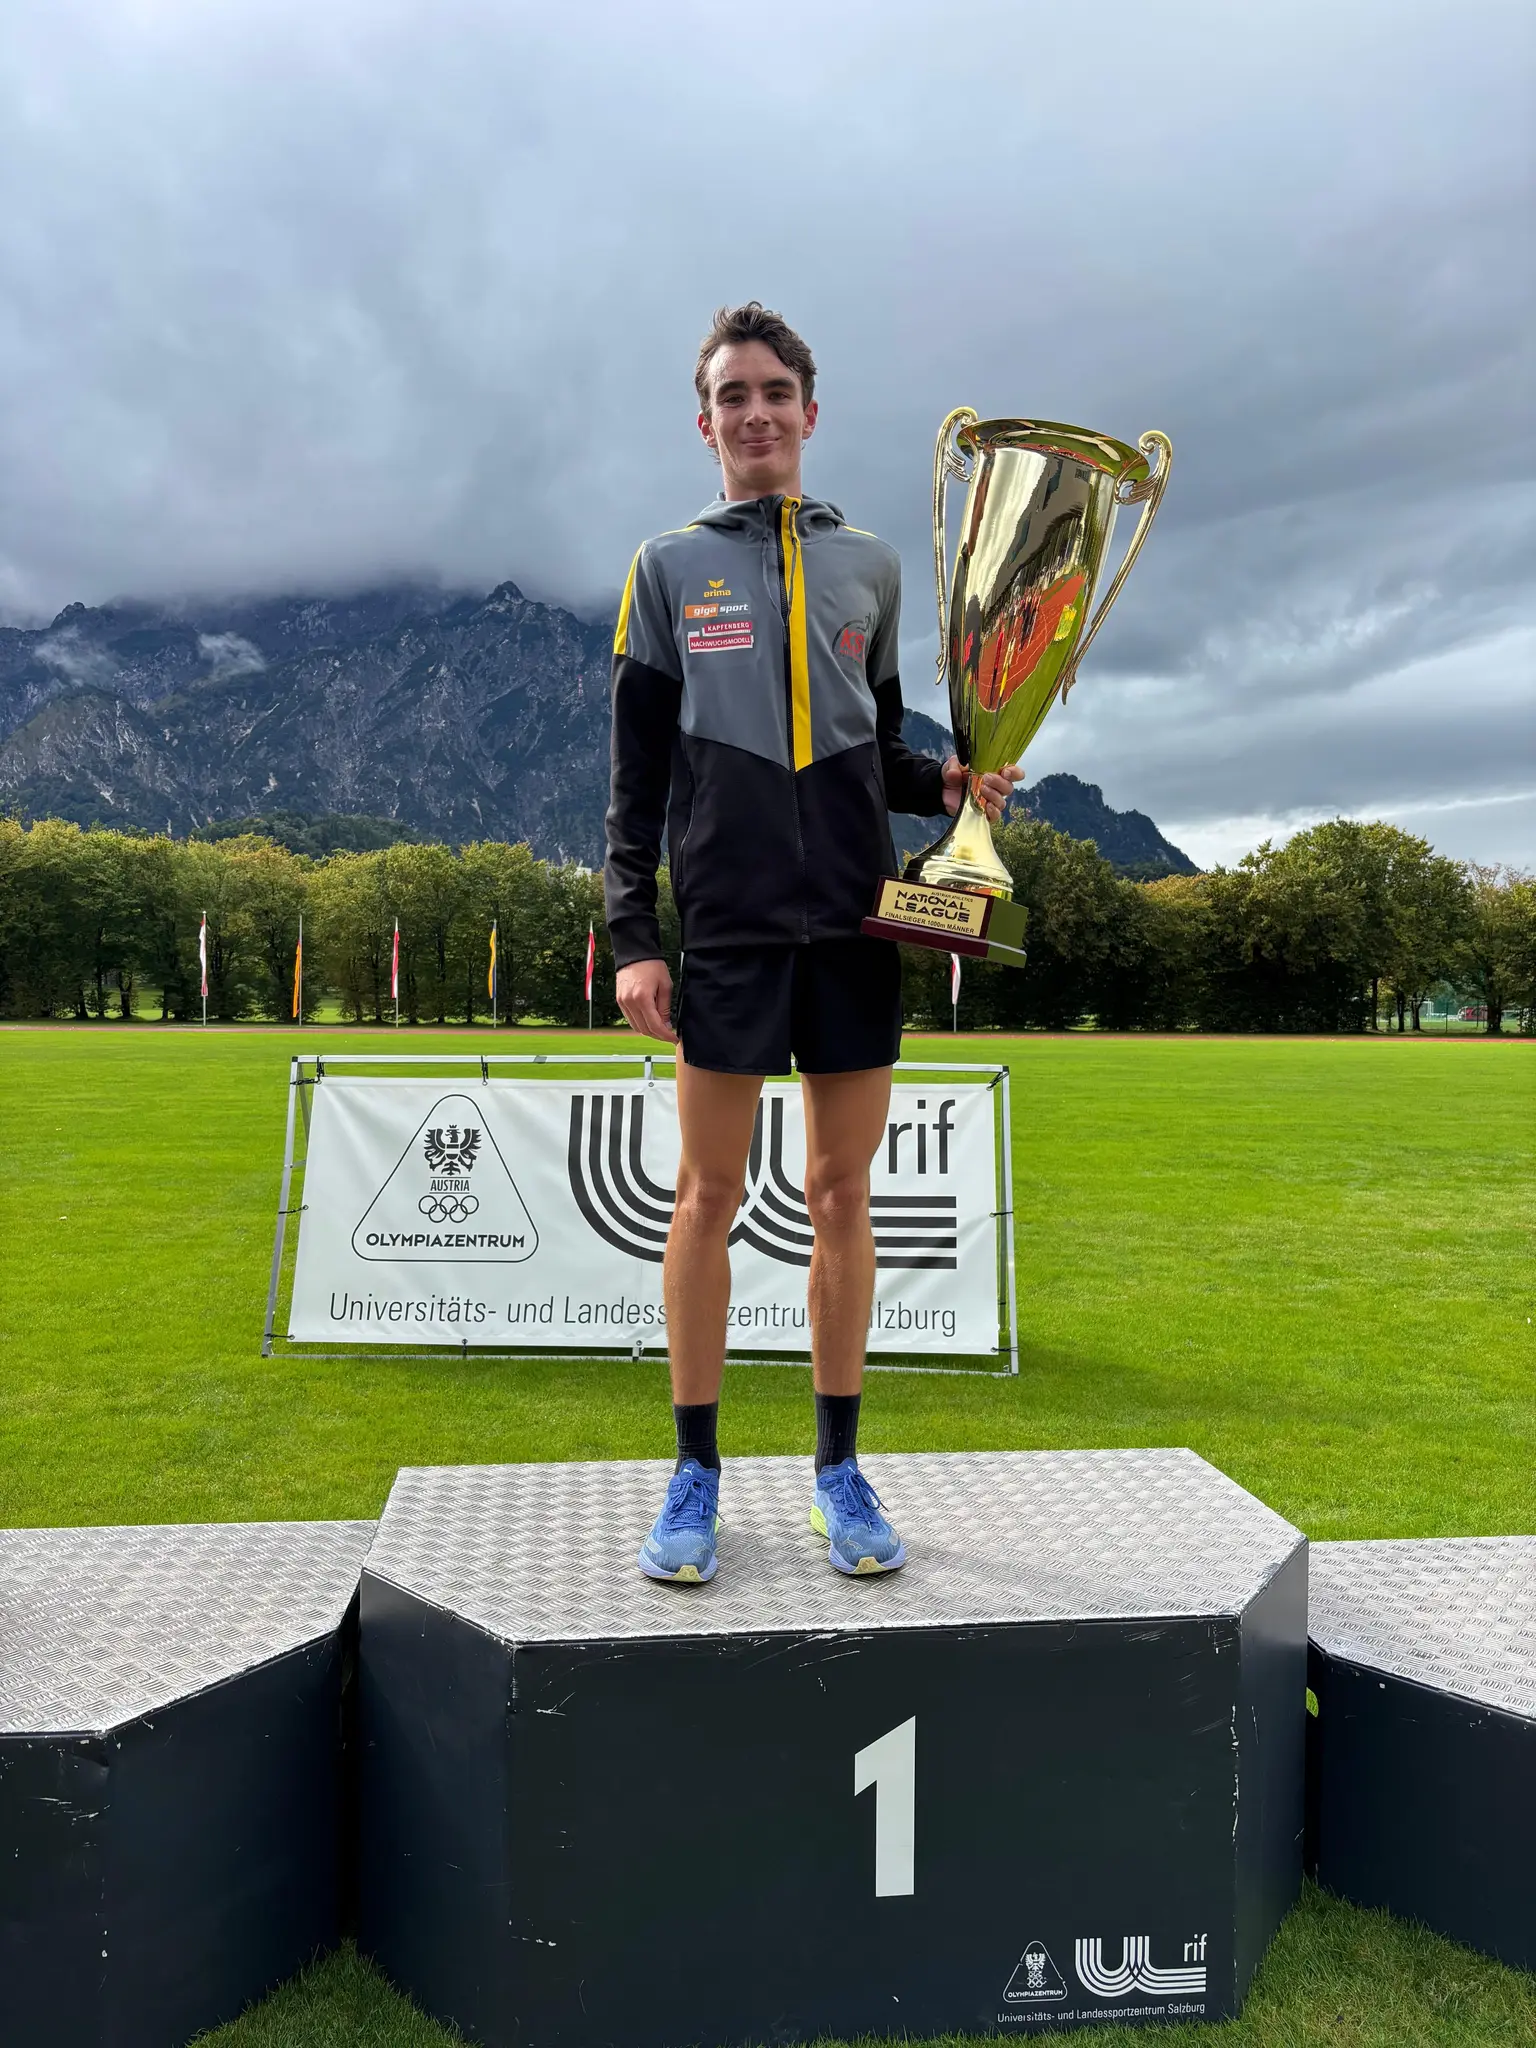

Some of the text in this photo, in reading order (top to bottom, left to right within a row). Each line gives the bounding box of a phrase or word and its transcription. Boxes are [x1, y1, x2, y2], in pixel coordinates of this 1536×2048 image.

[704, 589, 731, 598] erima
[694, 603, 749, 616] giga sport
[707, 622, 750, 632] KAPFENBERG
[691, 637, 750, 648] NACHWUCHSMODELL
[897, 890, 970, 911] NATIONAL
[885, 912, 926, 924] FINALSIEGER
[894, 900, 970, 923] LEAGUE
[888, 1099, 956, 1175] rif
[430, 1178, 470, 1192] AUSTRIA
[366, 1232, 525, 1249] OLYMPIAZENTRUM
[329, 1292, 497, 1324] Universitäts-
[507, 1296, 554, 1324] und
[868, 1301, 956, 1337] lzburg
[854, 1715, 916, 1898] 1
[1183, 1933, 1208, 1962] rif
[1007, 1989, 1064, 1999] OLYMPIAZENTRUM
[997, 2002, 1206, 2023] Universitäts- und Landessportzentrum Salzburg
